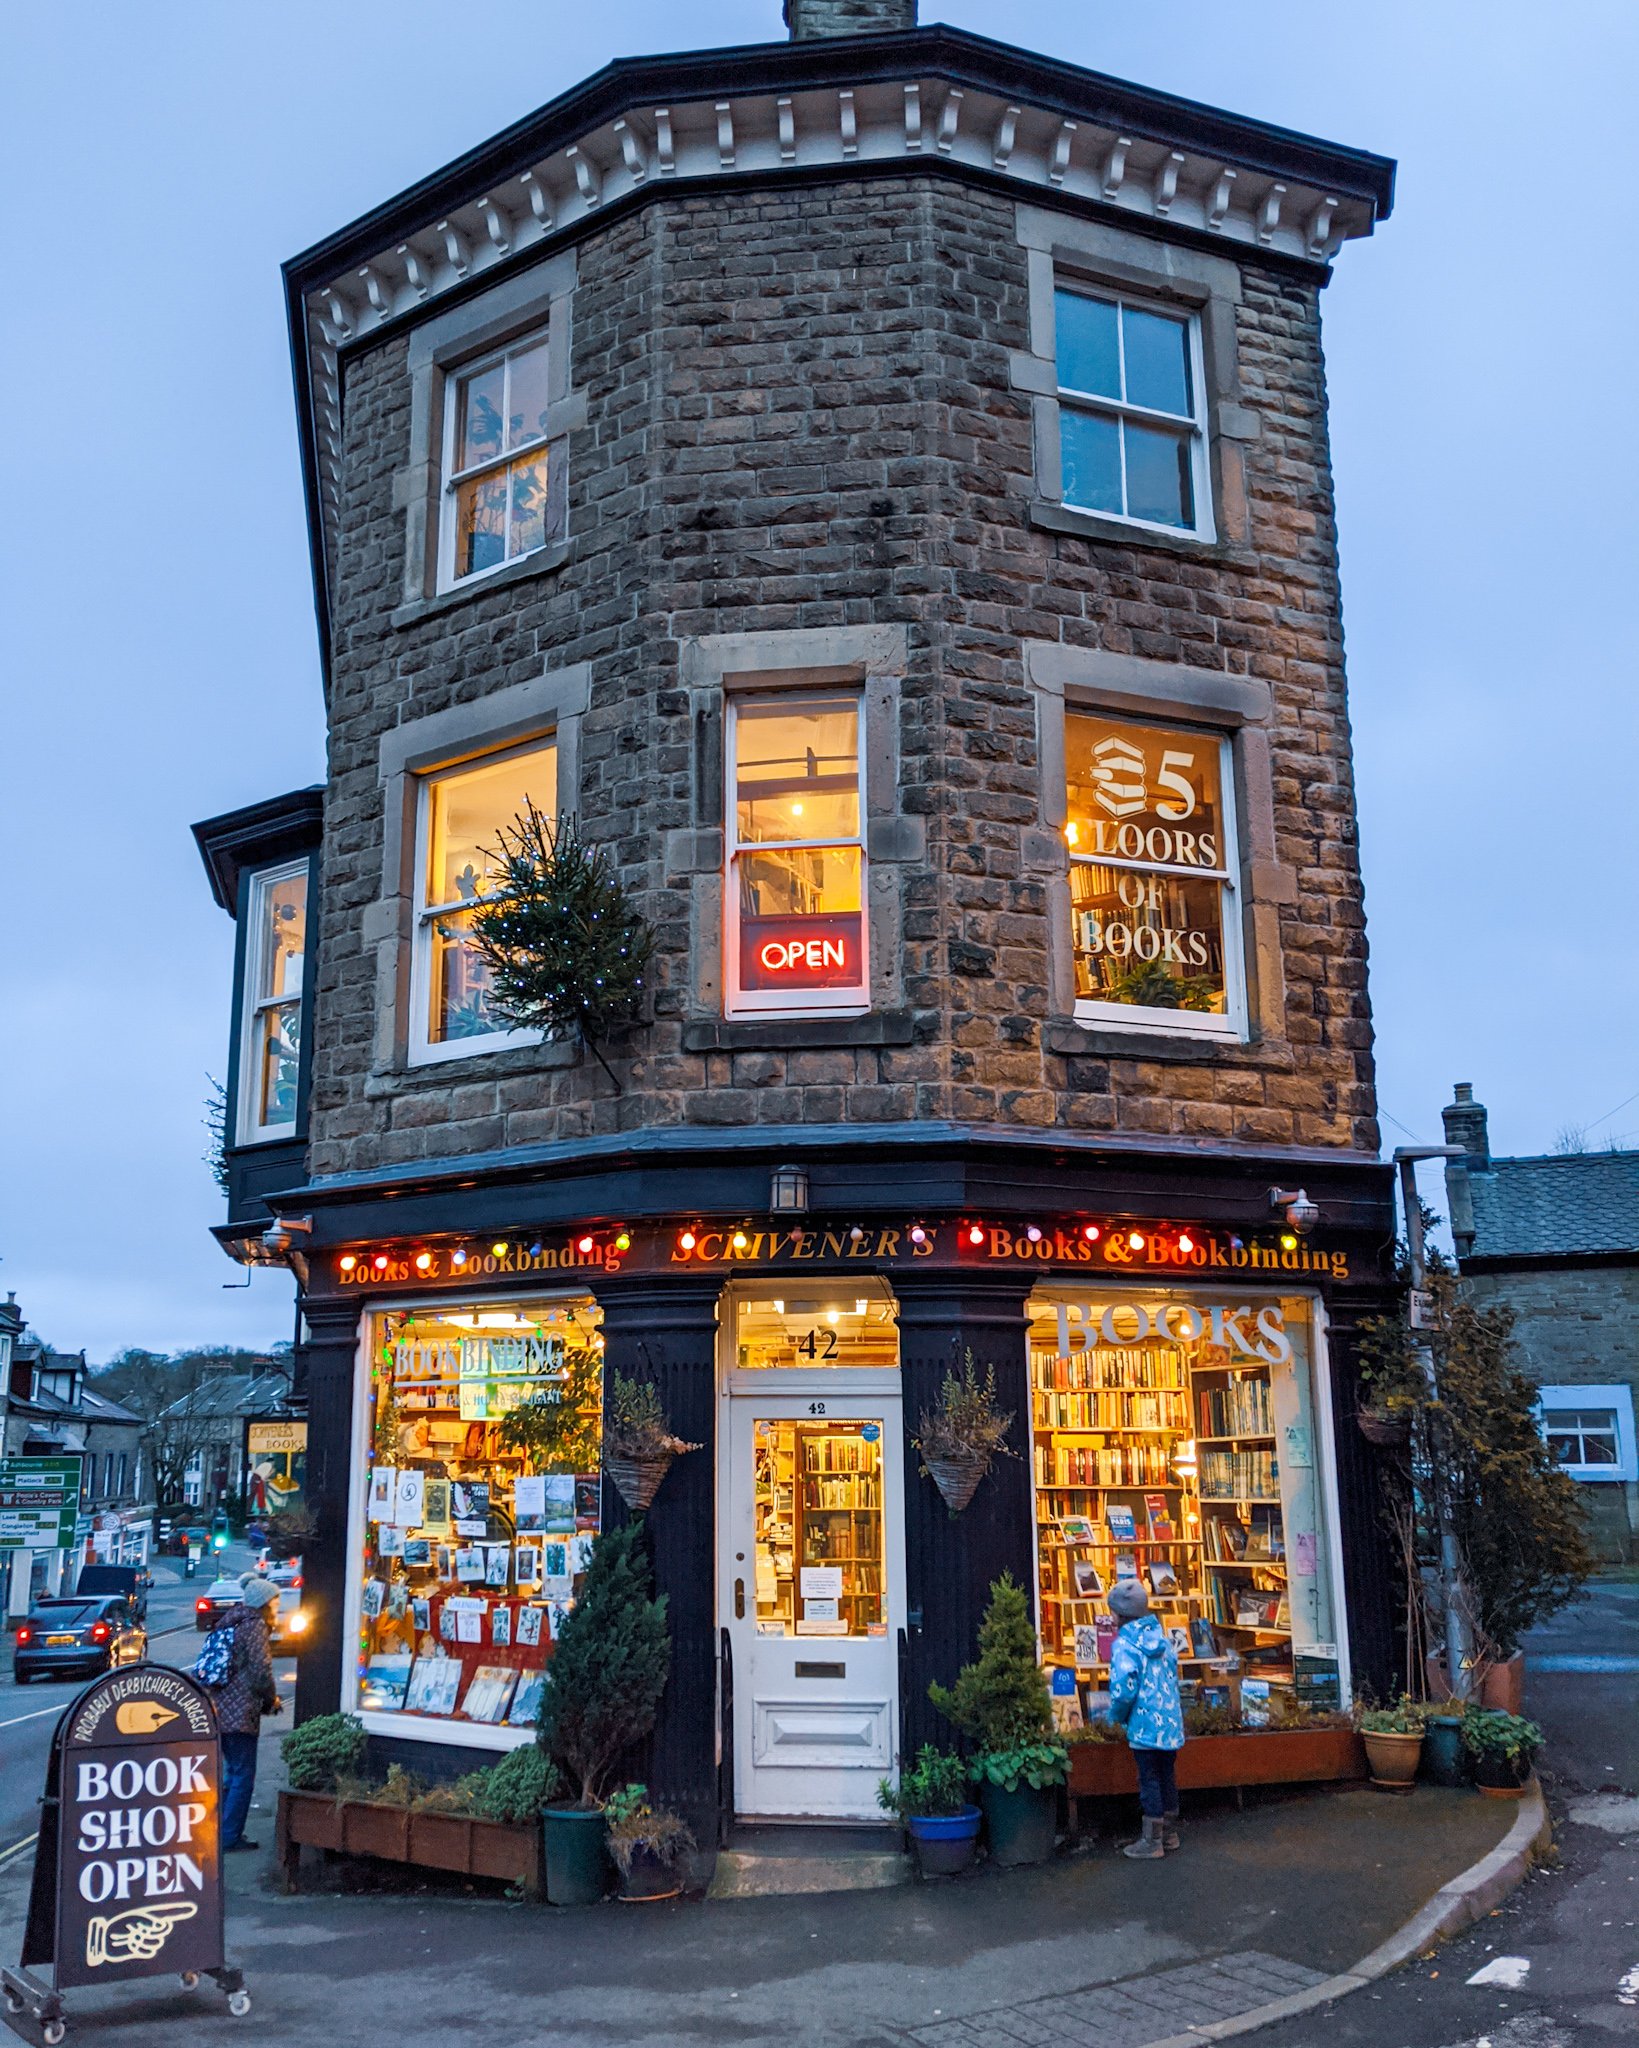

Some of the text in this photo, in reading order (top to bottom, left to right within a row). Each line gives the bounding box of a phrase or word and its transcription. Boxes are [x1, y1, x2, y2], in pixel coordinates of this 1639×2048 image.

[1155, 750, 1195, 821] 5
[1118, 874, 1168, 910] OF
[761, 938, 844, 970] OPEN
[1082, 918, 1207, 966] BOOKS
[988, 1228, 1349, 1279] Books & Bookbinding
[393, 1332, 564, 1377] BOOKBINDING
[799, 1329, 839, 1360] 42
[1054, 1301, 1291, 1364] BOOKS
[808, 1402, 826, 1414] 42
[75, 1675, 211, 1743] PROBABLY DERBYSHIRE'S LARGEST
[76, 1755, 211, 1802] BOOK
[78, 1803, 207, 1852] SHOP
[79, 1854, 203, 1903] OPEN
